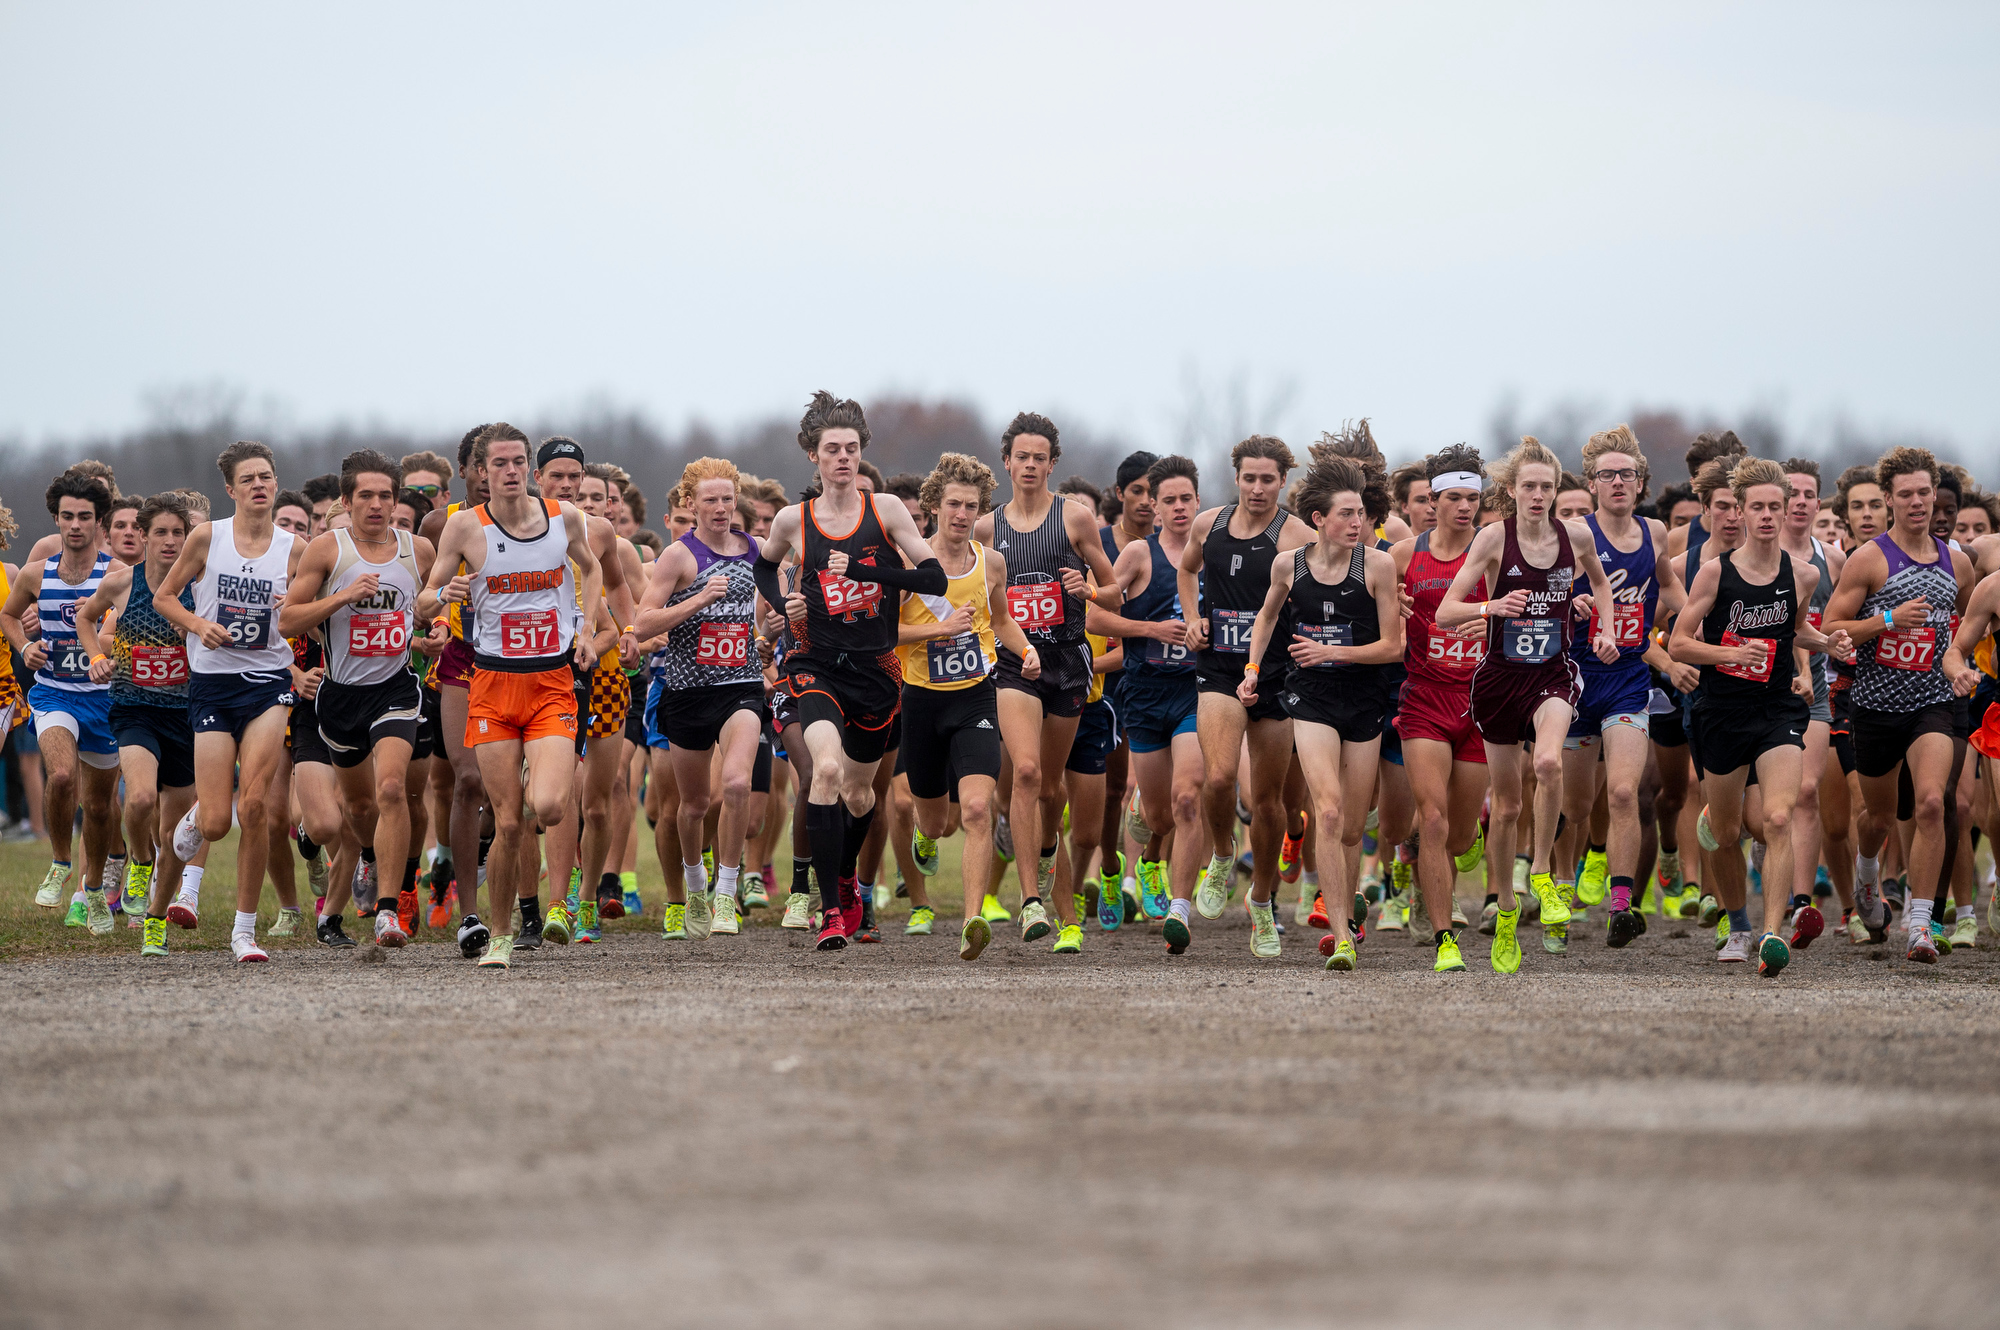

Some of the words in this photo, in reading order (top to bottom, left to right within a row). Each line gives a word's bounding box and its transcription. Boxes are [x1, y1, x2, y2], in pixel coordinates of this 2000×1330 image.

[1230, 554, 1242, 576] P
[218, 574, 272, 592] GRAND
[826, 580, 878, 606] 525
[1607, 568, 1651, 604] Cal
[218, 586, 270, 605] HAVEN
[1509, 591, 1568, 602] AMAZO
[1014, 598, 1057, 621] 519
[1323, 601, 1334, 621] P
[1531, 603, 1547, 615] CC
[1726, 600, 1788, 634] Jesuit
[227, 622, 260, 643] 69
[352, 627, 405, 649] 540
[510, 625, 552, 648] 517
[1221, 624, 1253, 645] 114
[699, 637, 746, 658] 508
[1428, 638, 1483, 661] 544
[1516, 634, 1550, 655] 87
[1879, 638, 1932, 663] 507
[62, 652, 92, 671] 40
[136, 659, 184, 679] 532
[934, 650, 977, 675] 160
